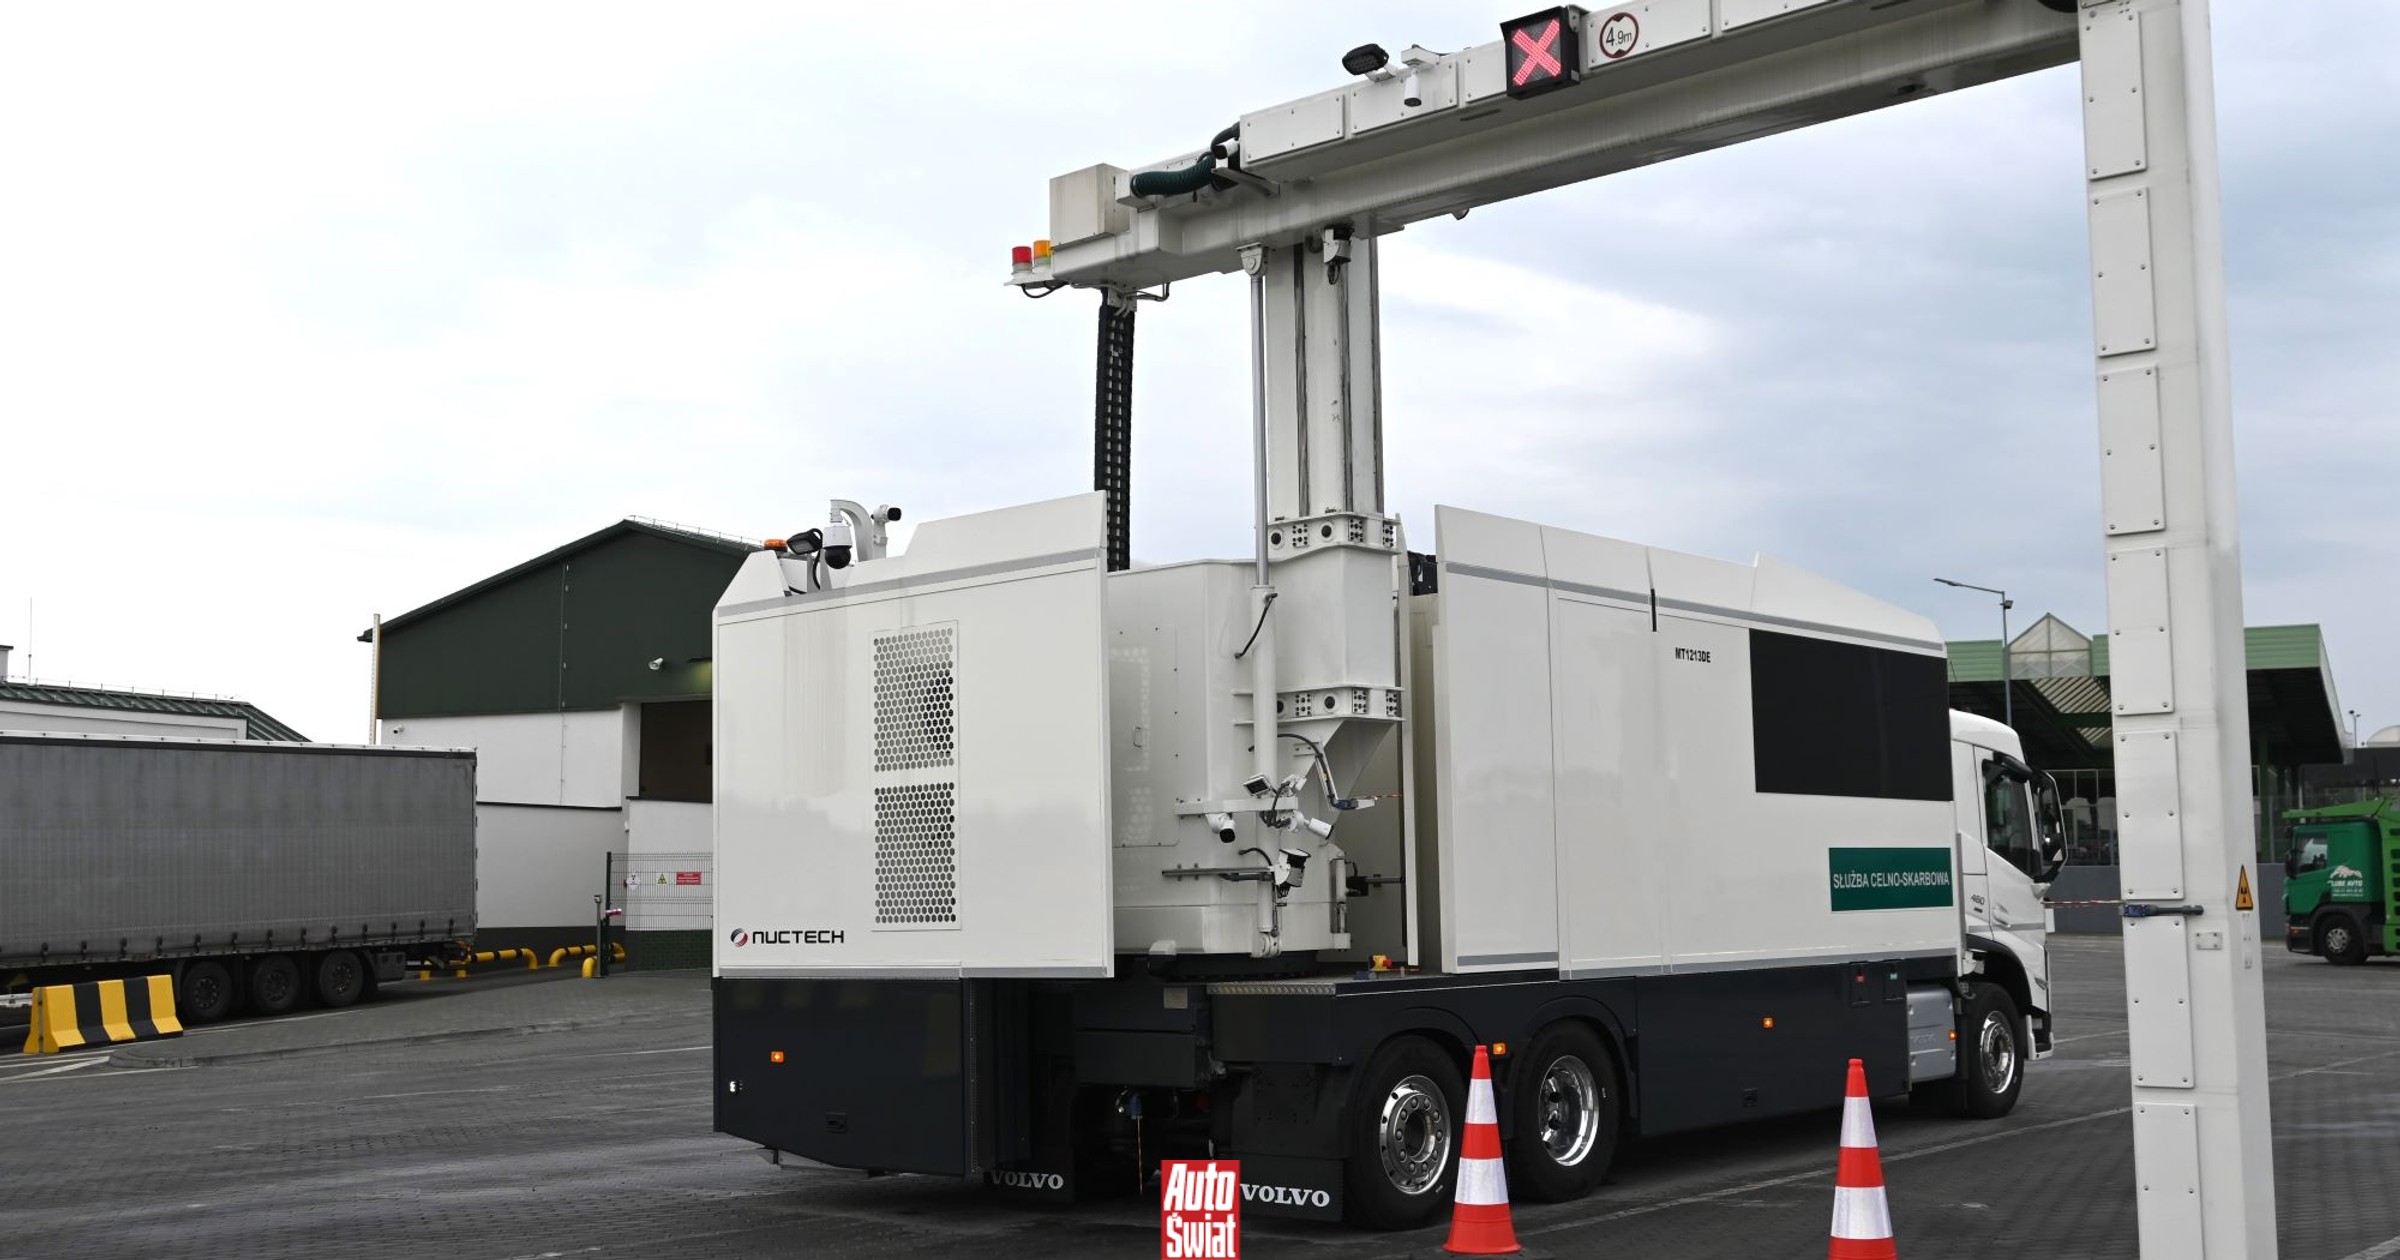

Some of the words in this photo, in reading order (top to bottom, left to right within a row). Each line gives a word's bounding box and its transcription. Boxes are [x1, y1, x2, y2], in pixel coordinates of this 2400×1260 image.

[1605, 26, 1632, 46] 4.9m
[1675, 647, 1711, 663] MT1213DE
[1833, 870, 1869, 889] SŁUŻBA
[1870, 871, 1950, 888] CELNO-SKARBOWA
[752, 930, 844, 944] NUCTECH
[991, 1170, 1064, 1190] VOLVO
[1241, 1183, 1331, 1208] VOLVO
